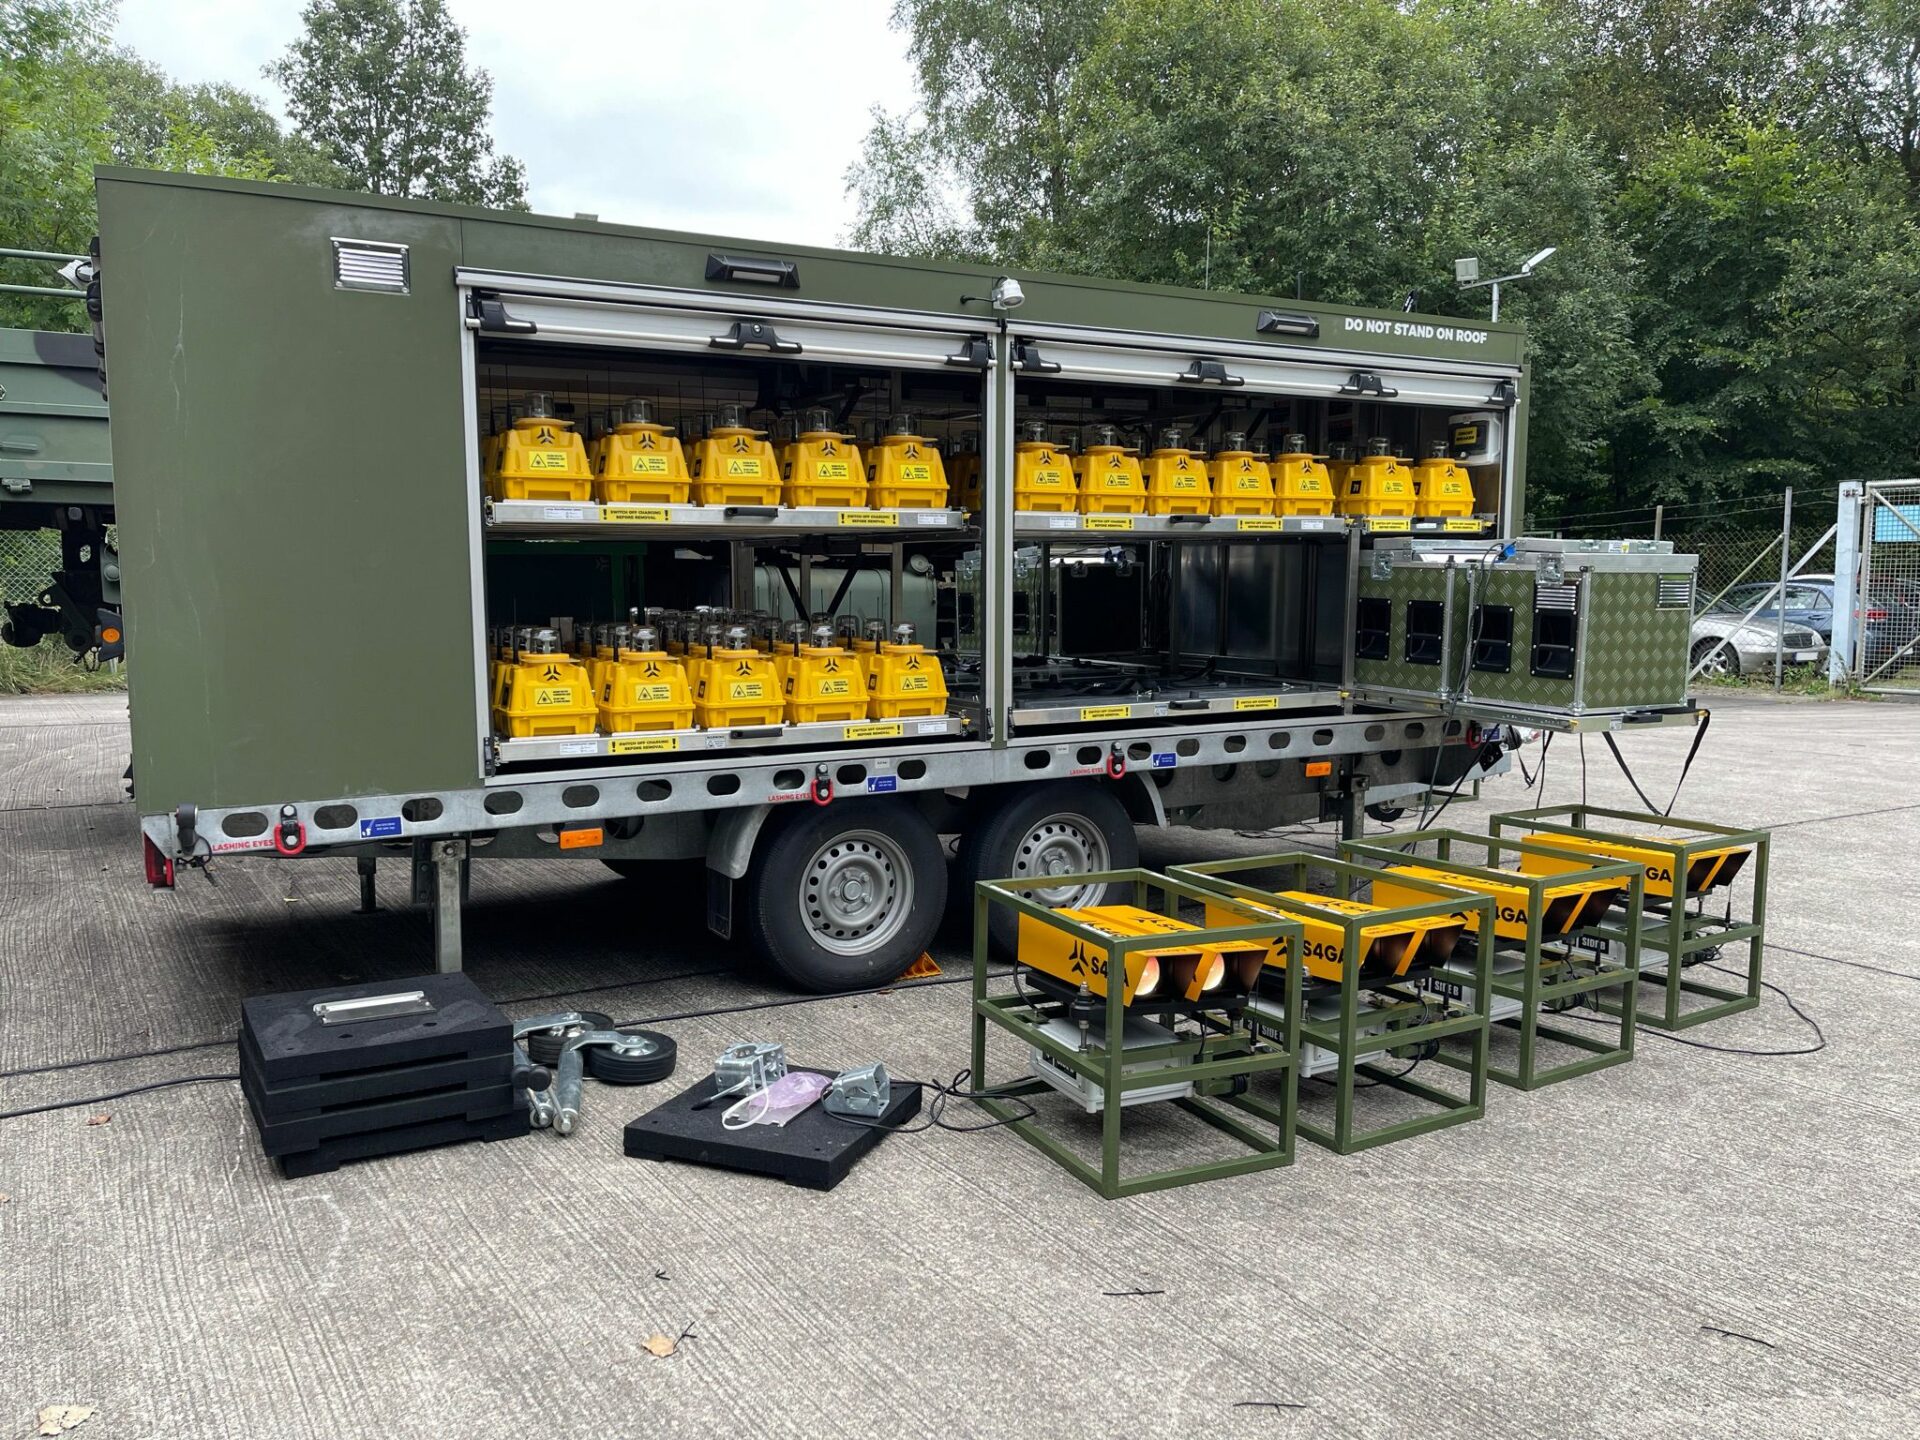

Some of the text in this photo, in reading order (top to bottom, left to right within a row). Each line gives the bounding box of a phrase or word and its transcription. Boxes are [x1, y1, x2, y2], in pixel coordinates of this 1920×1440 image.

[1345, 318, 1488, 344] DO NOT STAND ON ROOF
[768, 792, 810, 801] LASHING EYES
[212, 839, 273, 851] LASHING EYES
